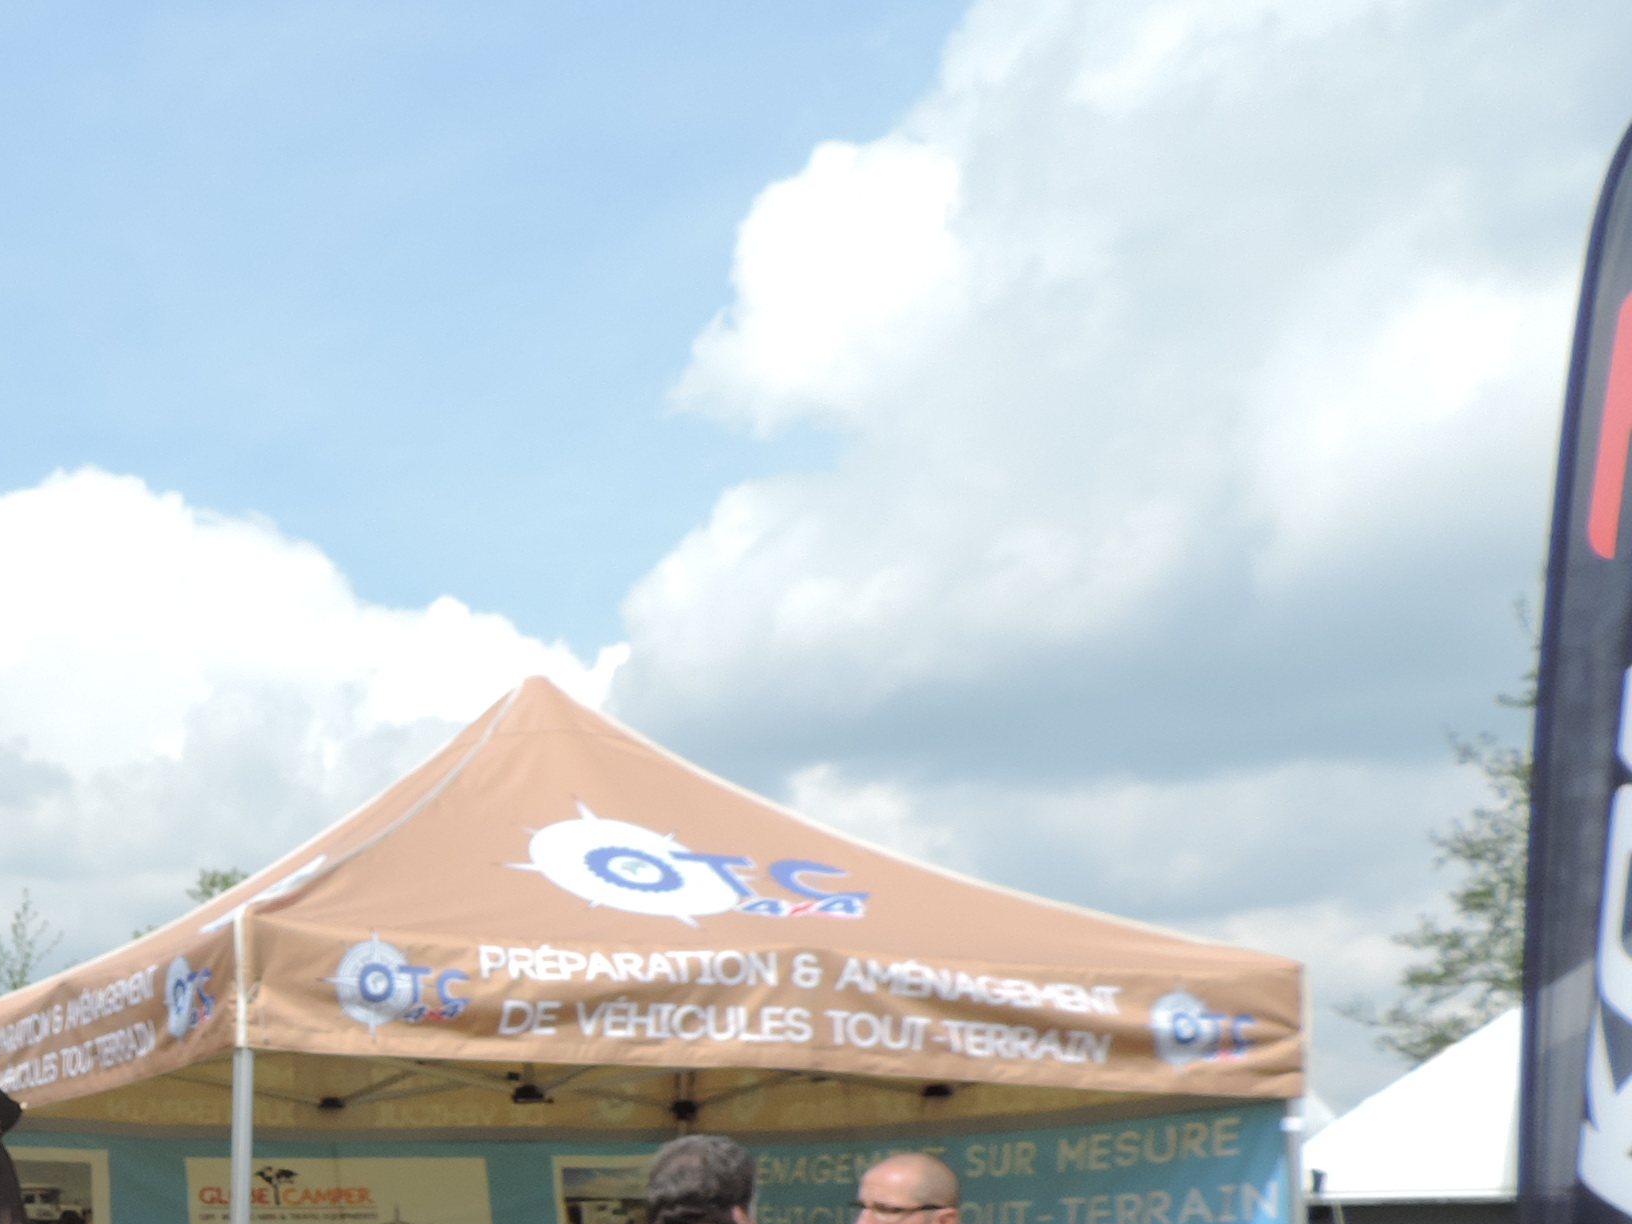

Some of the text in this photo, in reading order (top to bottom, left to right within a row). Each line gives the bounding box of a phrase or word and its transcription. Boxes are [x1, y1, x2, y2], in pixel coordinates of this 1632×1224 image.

[359, 963, 472, 1006] OTC
[478, 944, 1123, 1014] PRÉPARATION & AMÉNAGEMENT
[498, 1000, 562, 1035] DE
[576, 996, 813, 1042] VÉHICULES
[966, 1140, 1037, 1178] SUR
[1057, 1116, 1242, 1172] MESURE
[282, 1187, 375, 1206] CAMPER
